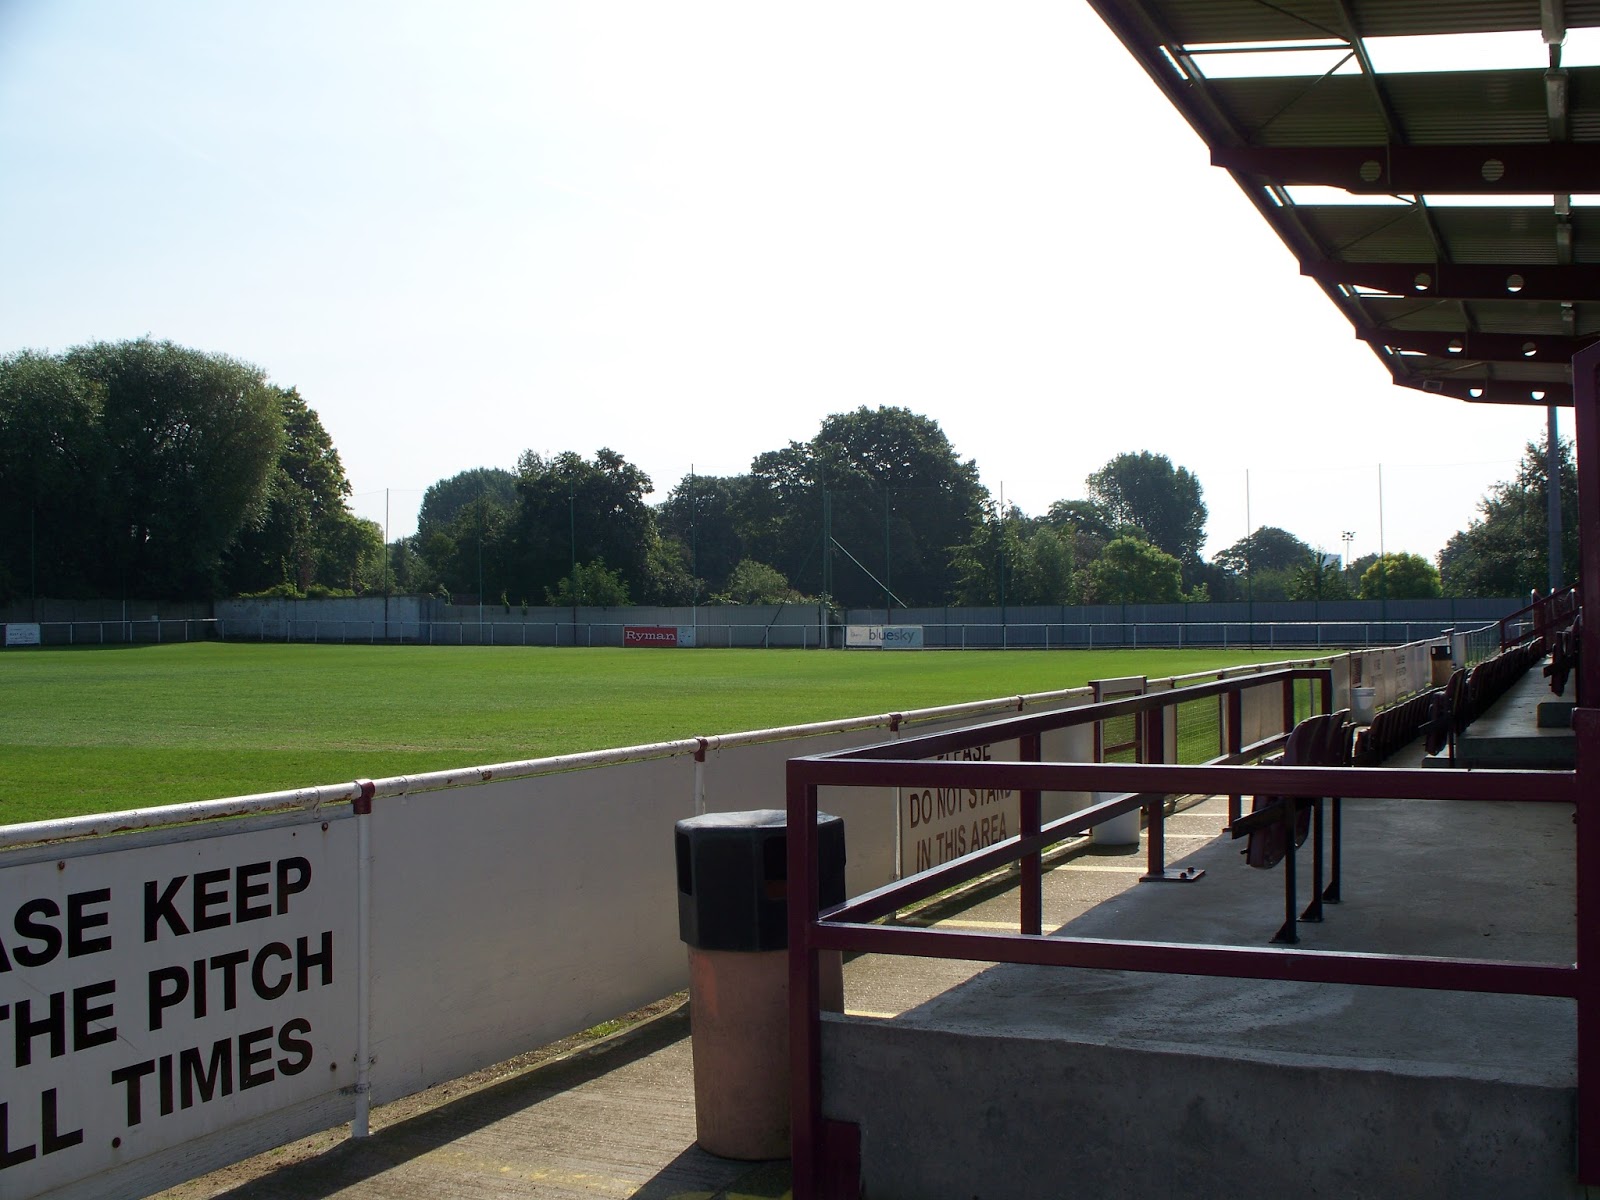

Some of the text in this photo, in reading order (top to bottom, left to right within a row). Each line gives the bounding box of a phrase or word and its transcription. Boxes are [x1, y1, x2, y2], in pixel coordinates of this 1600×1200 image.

[625, 630, 675, 641] Ryman
[868, 628, 915, 643] bluesky
[909, 790, 932, 828] DO
[937, 787, 962, 820] NOT
[917, 812, 1007, 873] IN THIS AREA
[144, 856, 312, 943] KEEP
[148, 930, 333, 1032] PITCH
[111, 1018, 313, 1128] TIMES
